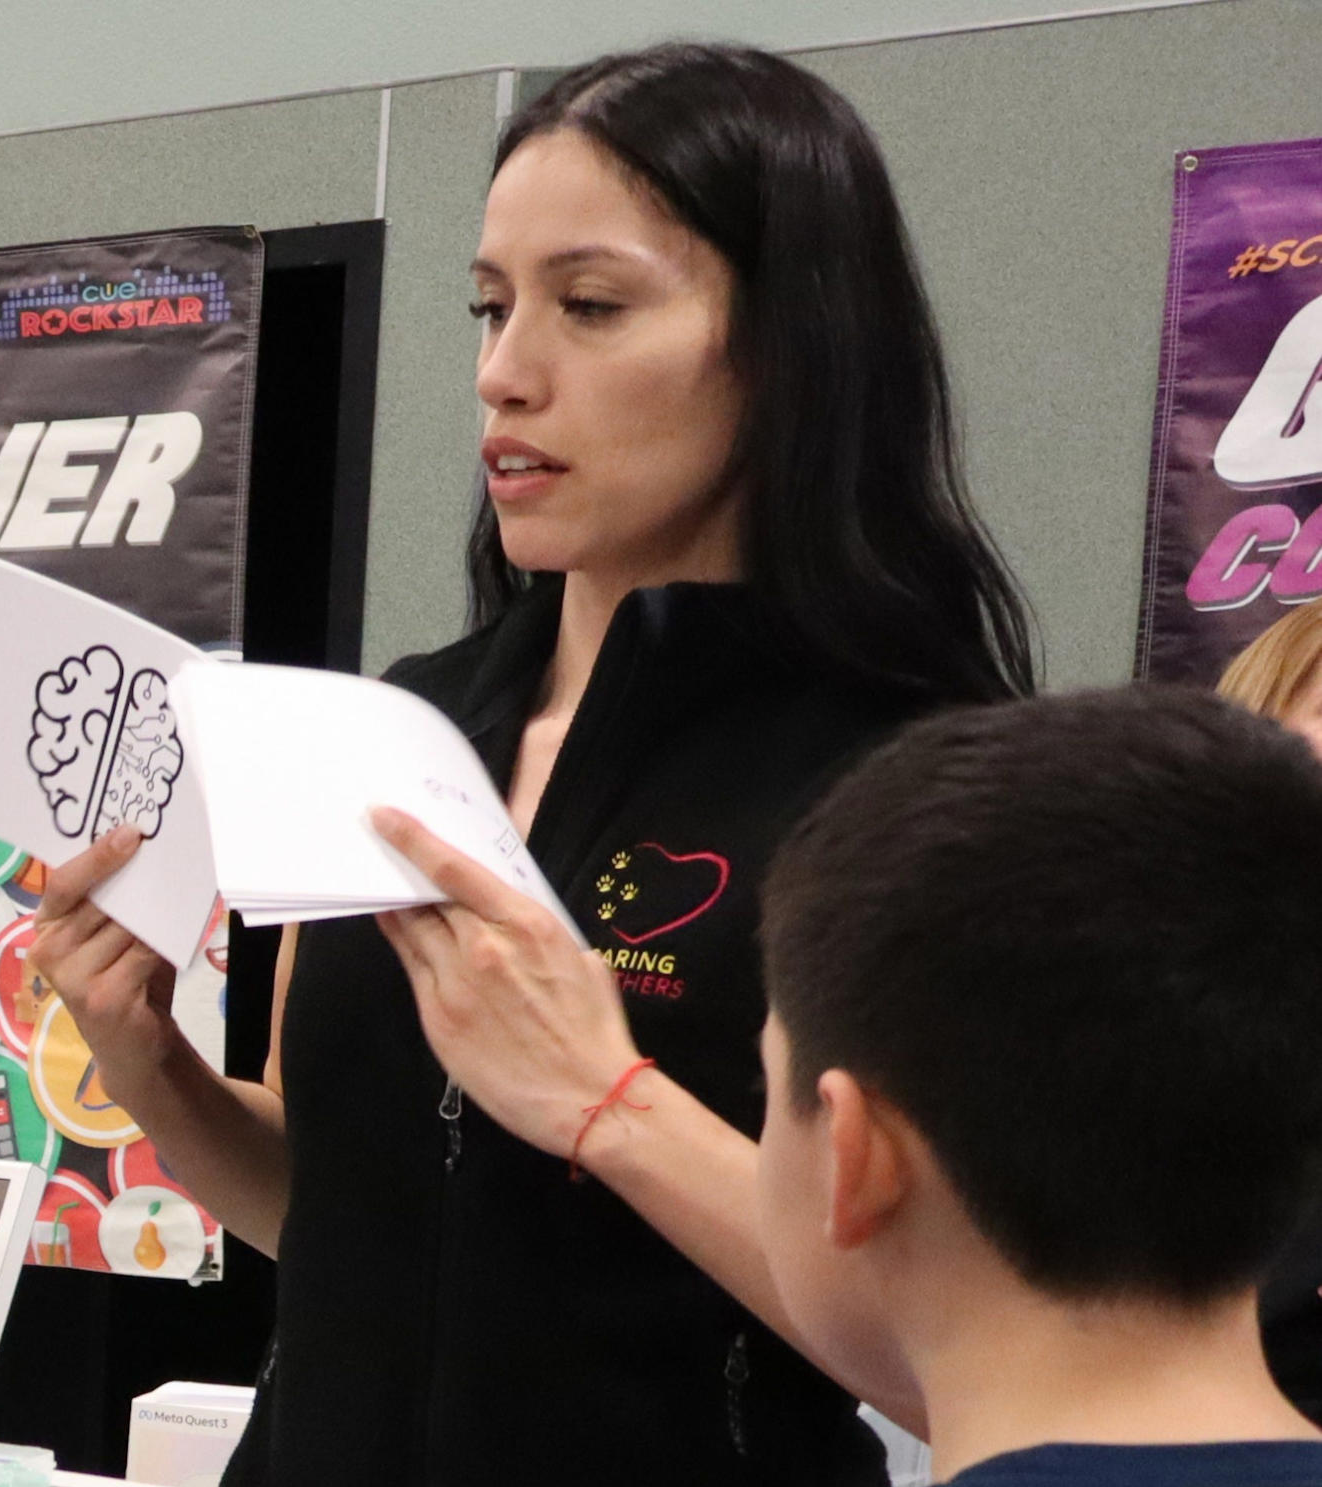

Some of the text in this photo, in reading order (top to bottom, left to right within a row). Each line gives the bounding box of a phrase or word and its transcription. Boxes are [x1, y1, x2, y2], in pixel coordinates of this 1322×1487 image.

[19, 297, 204, 338] ROCKSTAR
[592, 948, 676, 975] ARING
[154, 1411, 228, 1429] Meta Quest 3
